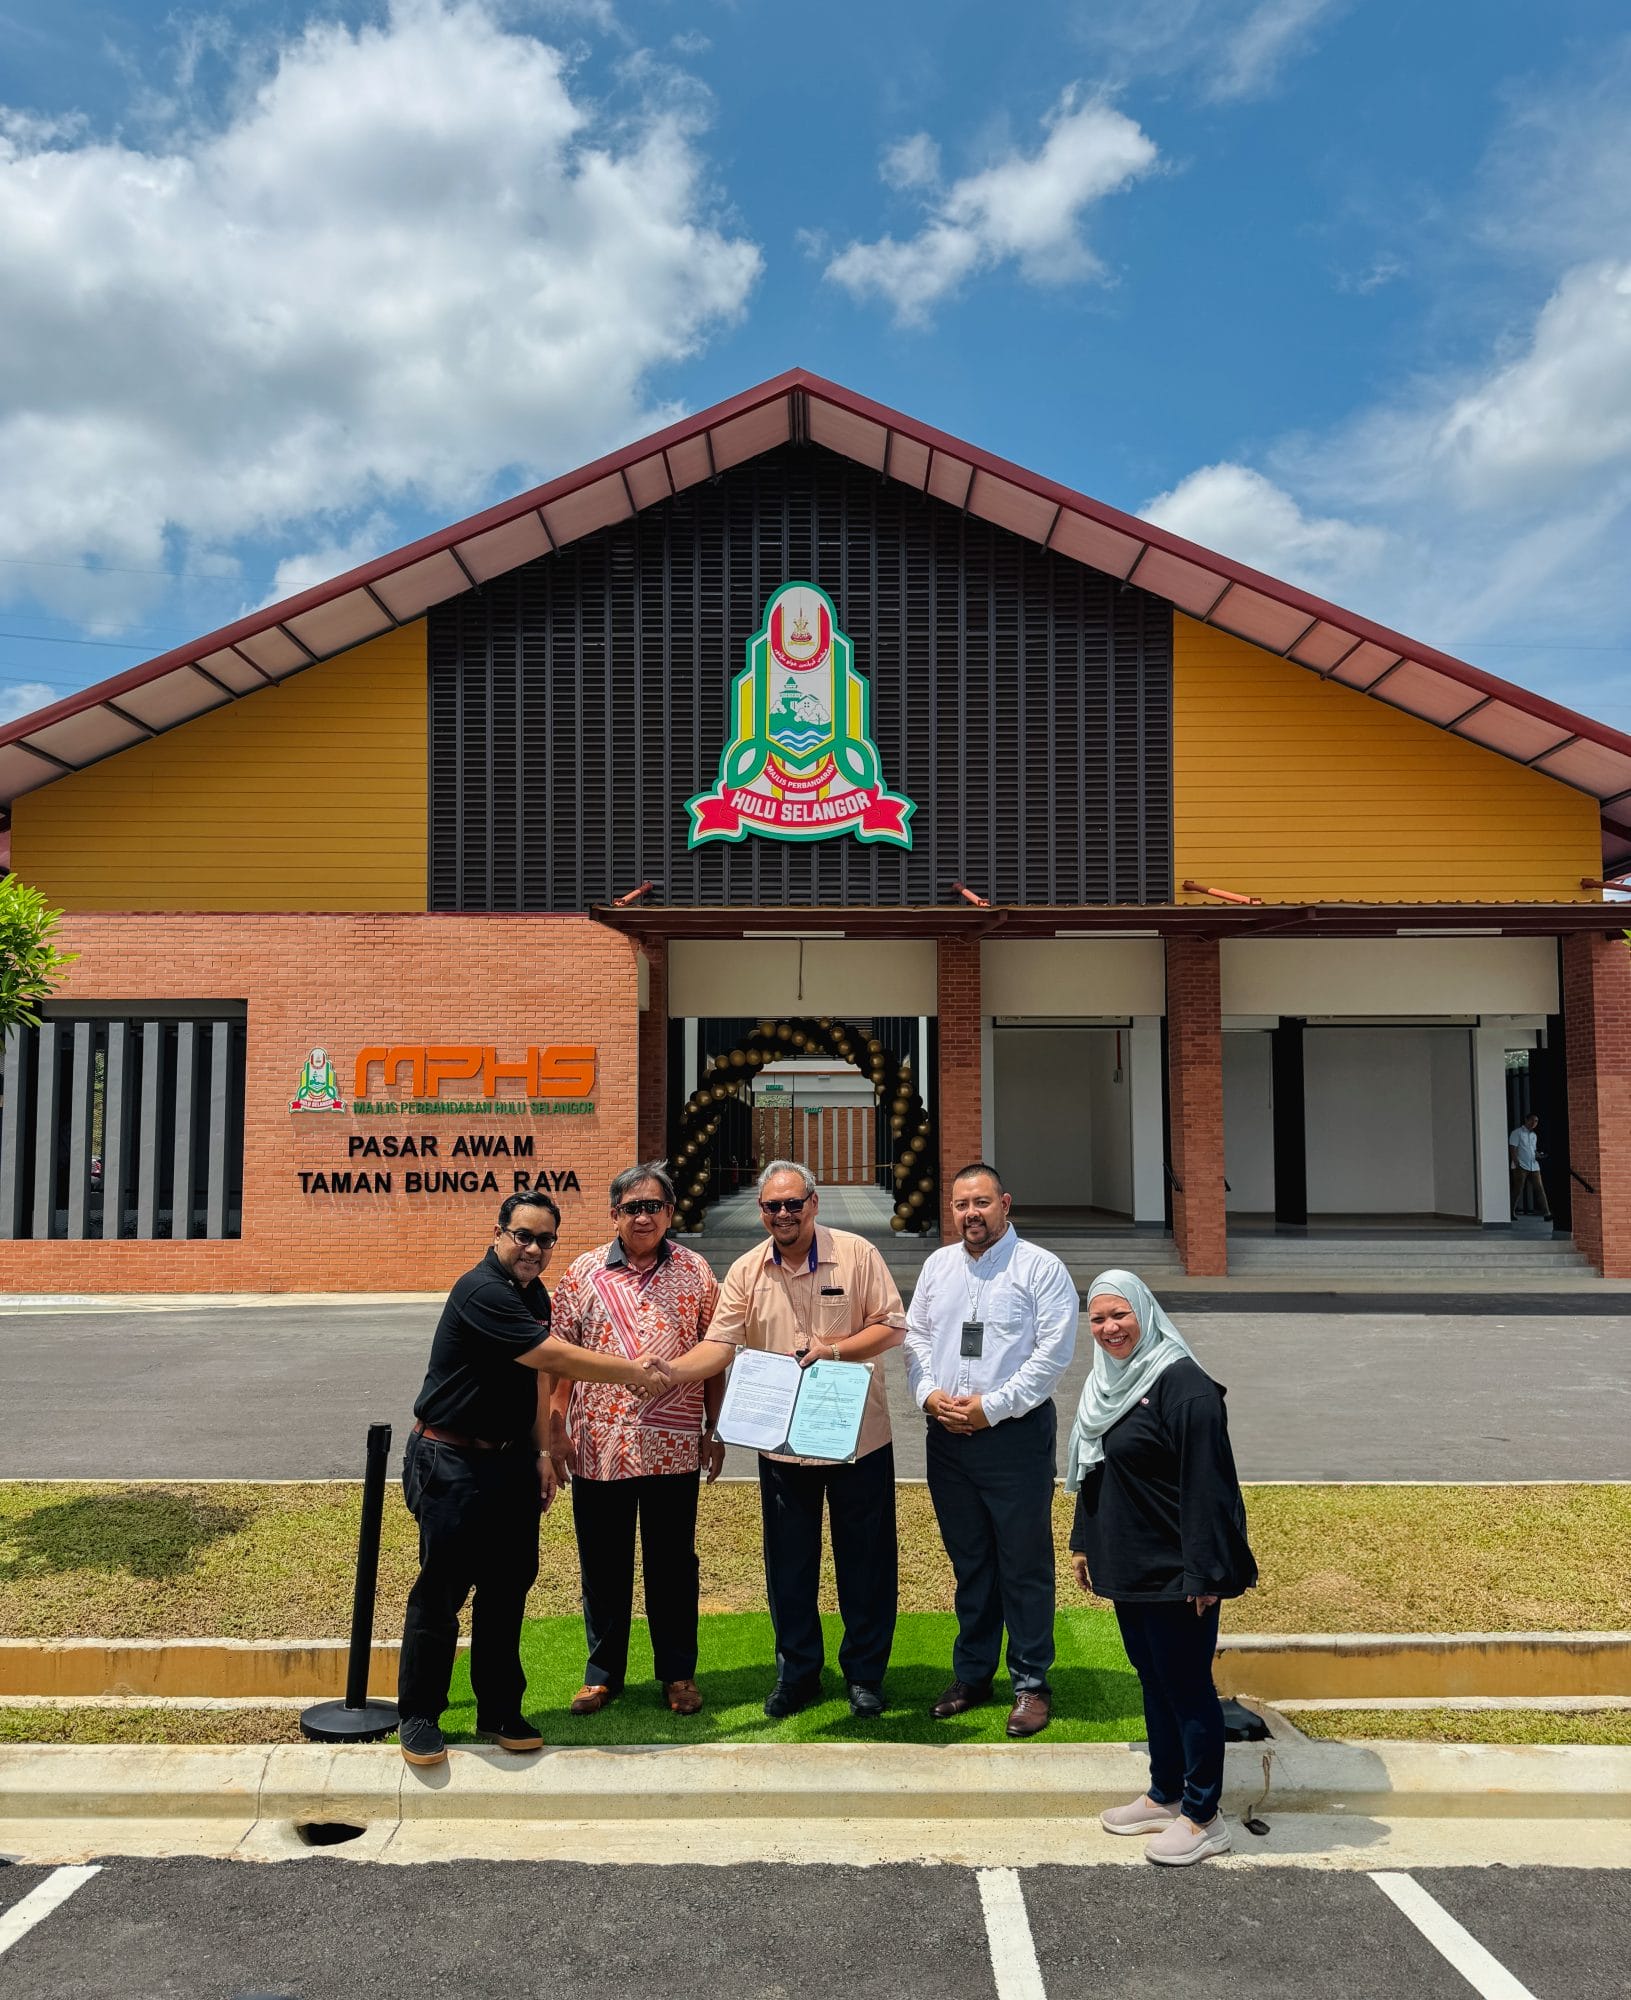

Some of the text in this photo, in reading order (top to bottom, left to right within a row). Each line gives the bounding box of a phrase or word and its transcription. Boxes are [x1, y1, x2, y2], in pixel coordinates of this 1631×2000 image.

[766, 764, 834, 789] MAJLIS PERBANDARAN
[730, 790, 872, 822] HULU SELANGOR
[354, 1046, 596, 1097] MPHS
[353, 1101, 595, 1115] MAJLIS PERBANDARAN HULU SELANGOR
[349, 1136, 534, 1158] PASAR AWAM
[298, 1170, 581, 1194] TAMAN BUNGA RAYA
